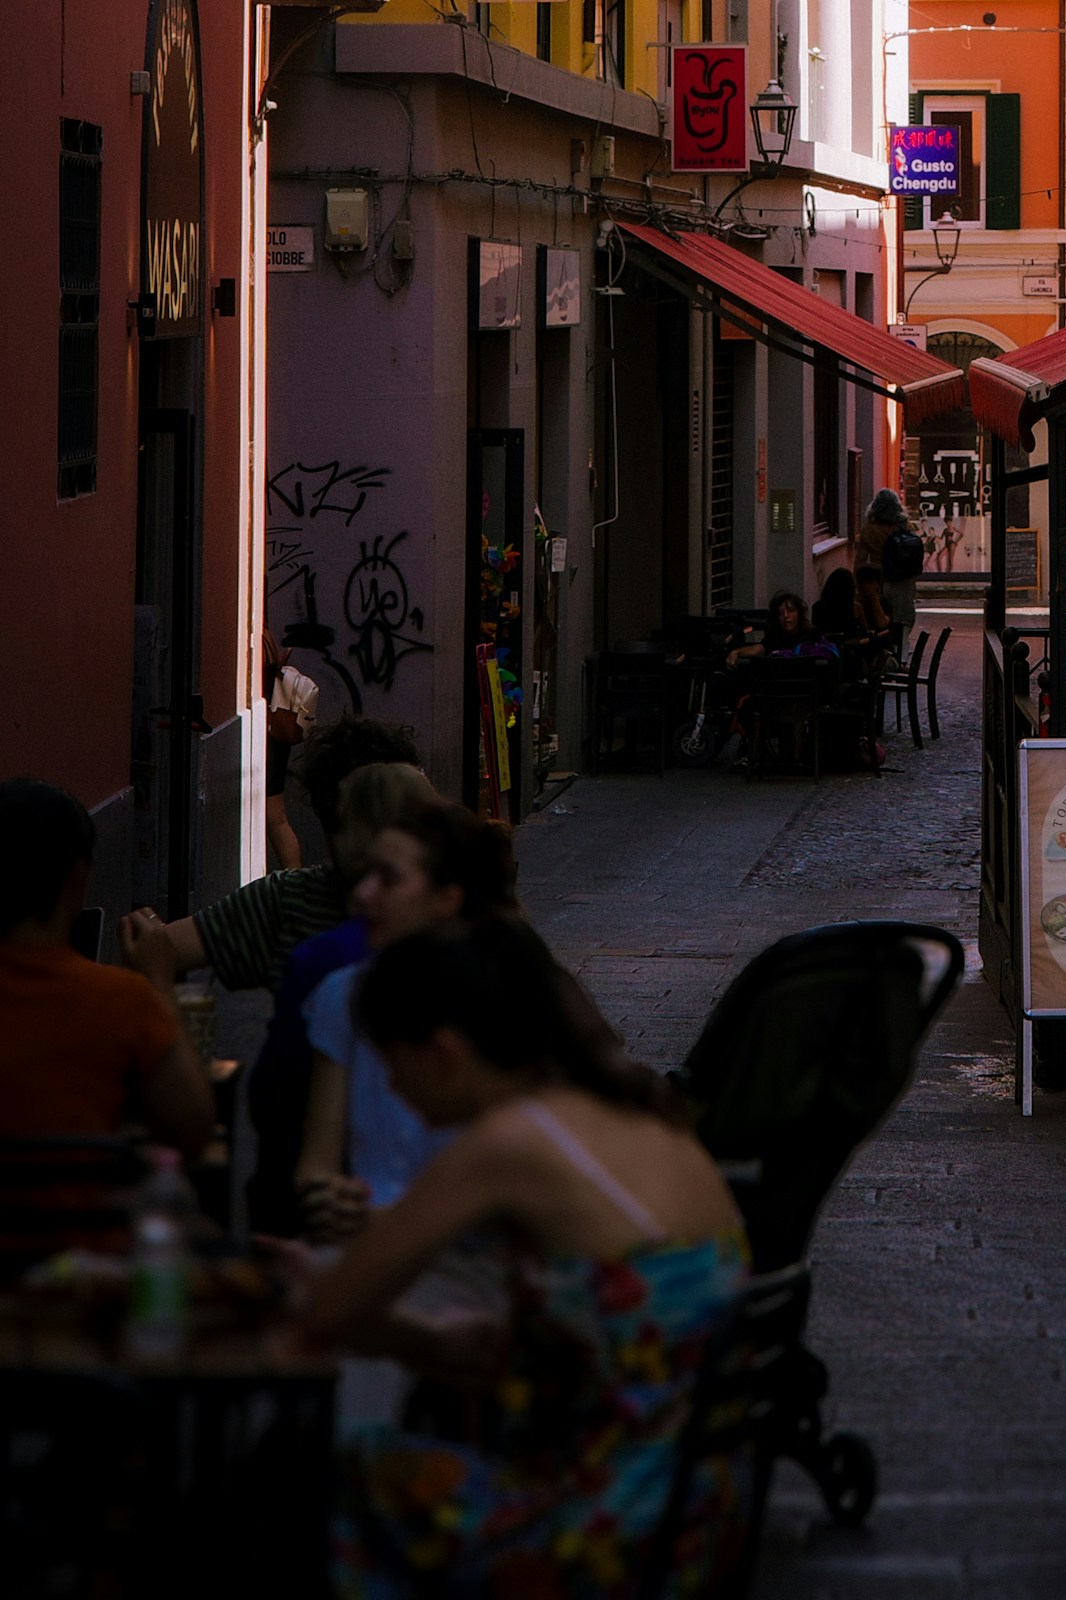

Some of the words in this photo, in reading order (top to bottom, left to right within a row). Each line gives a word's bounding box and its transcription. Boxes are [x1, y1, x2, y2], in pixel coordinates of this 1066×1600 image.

[910, 158, 955, 173] Gusto
[892, 175, 957, 193] Chengdu
[147, 218, 200, 321] WASABI
